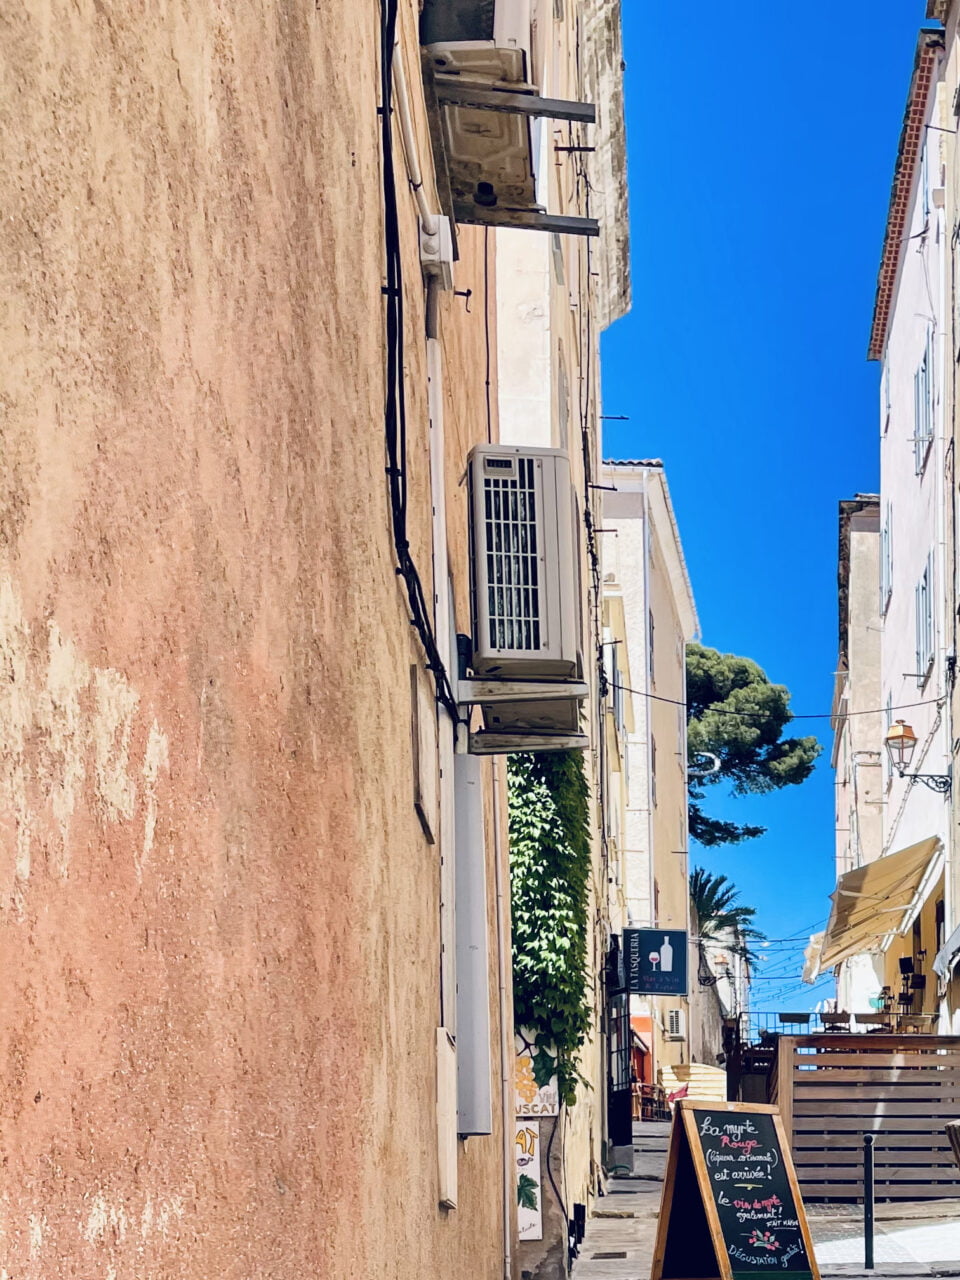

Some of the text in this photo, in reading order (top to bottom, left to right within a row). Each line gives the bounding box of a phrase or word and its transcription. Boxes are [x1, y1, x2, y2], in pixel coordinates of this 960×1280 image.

[630, 932, 640, 977] TASQUERIA
[515, 1104, 556, 1114] USCAT
[723, 1119, 759, 1142] myrte
[720, 1135, 763, 1155] Rouge
[714, 1168, 730, 1181] est
